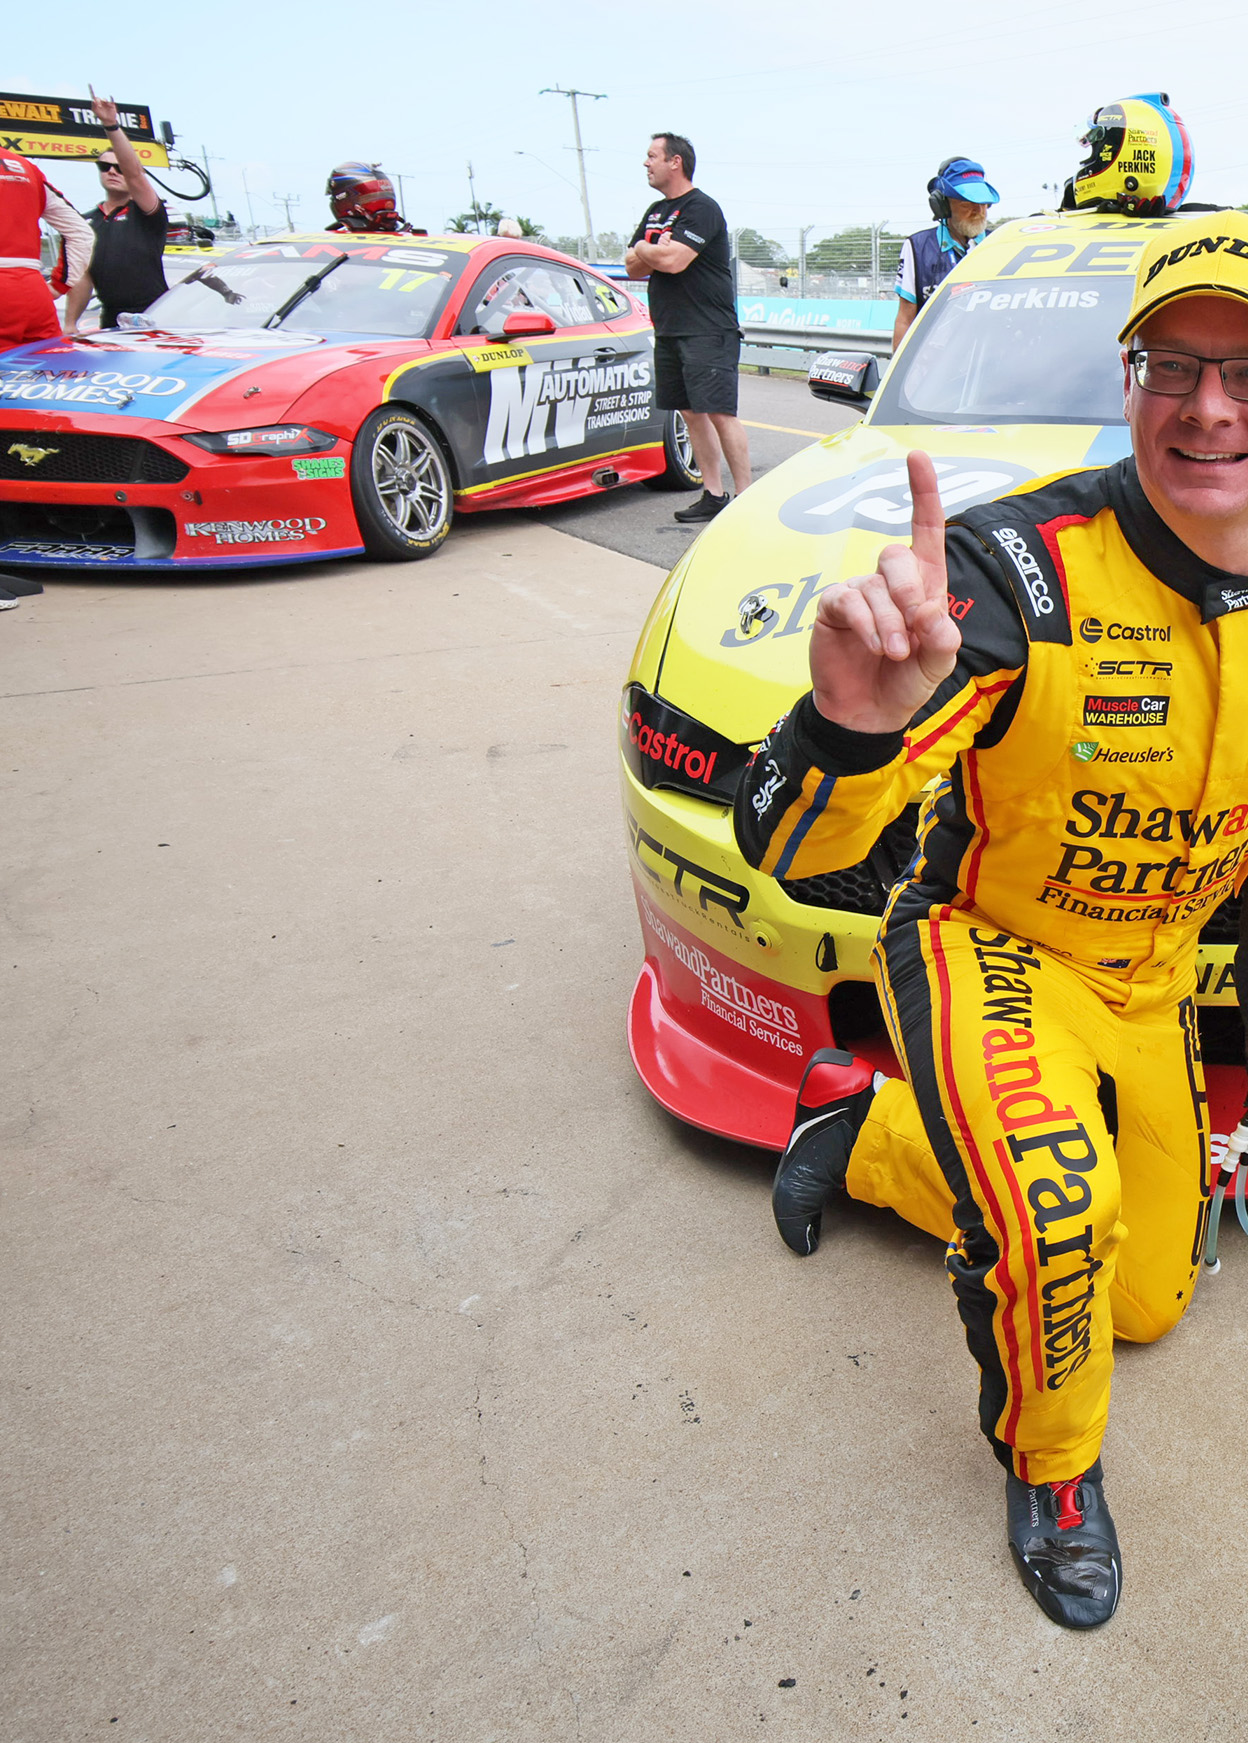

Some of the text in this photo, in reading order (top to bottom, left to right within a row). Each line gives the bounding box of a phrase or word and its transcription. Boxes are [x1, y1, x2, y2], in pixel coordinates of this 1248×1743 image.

[26, 141, 87, 154] TYRES
[1133, 150, 1155, 161] JACK
[1118, 162, 1155, 173] PERKINS
[379, 269, 439, 292] 17
[966, 286, 1100, 312] Perkins
[482, 349, 524, 362] DUNLOP
[540, 361, 651, 402] AUTOMATICS
[594, 391, 652, 412] STREET & STRIP
[587, 406, 650, 430] TRANSMISSIONS
[185, 517, 328, 537] KENWOOD
[215, 529, 306, 545] HOMES
[1107, 623, 1171, 642] Castrol
[1097, 660, 1173, 677] SCTR
[1088, 697, 1165, 712] Muscle Car
[1086, 712, 1164, 725] WAREHOUSE
[629, 711, 718, 784] Castrol
[1091, 747, 1174, 763] Haeusler's
[701, 989, 803, 1057] Financial Services
[1028, 1488, 1040, 1528] Partners
